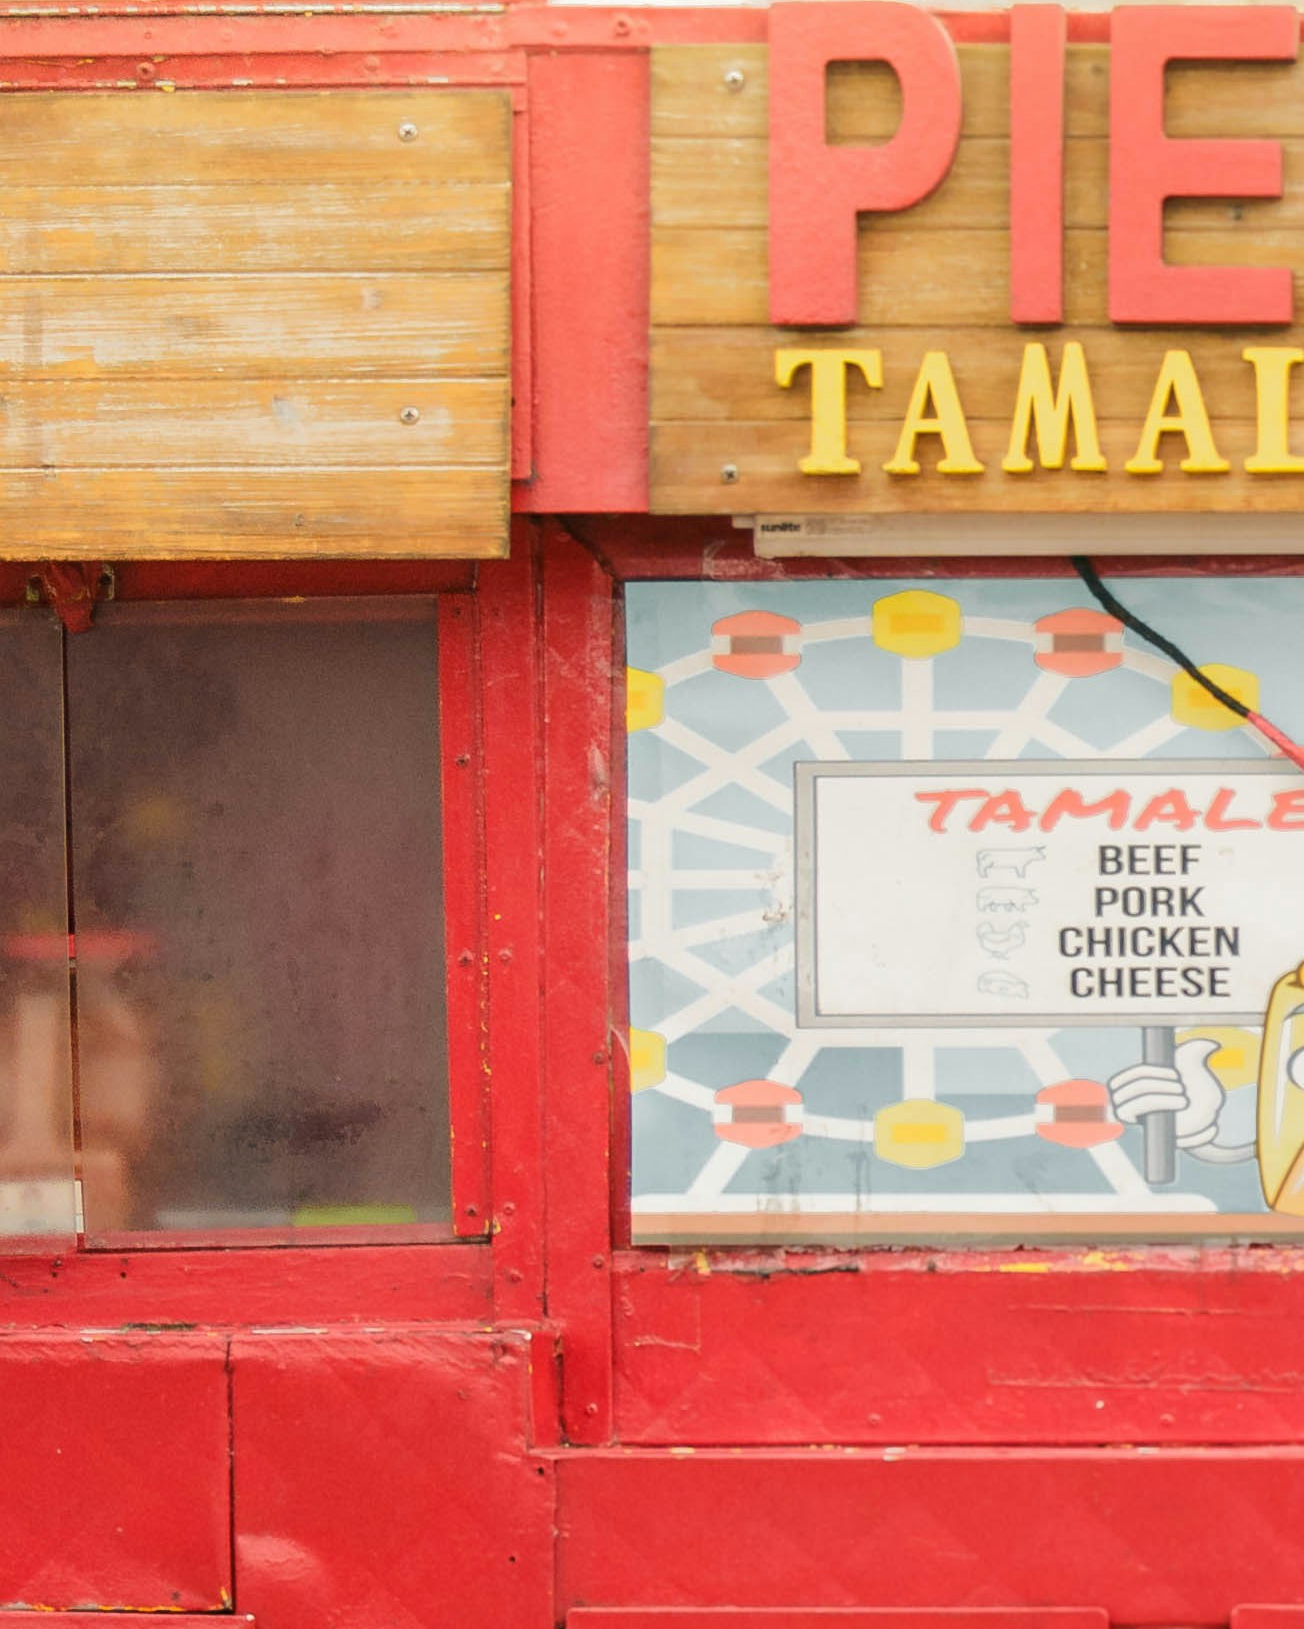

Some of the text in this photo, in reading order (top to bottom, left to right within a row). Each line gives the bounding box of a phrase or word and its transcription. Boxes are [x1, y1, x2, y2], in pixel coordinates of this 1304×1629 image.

[1097, 845, 1202, 875] BEEF
[1094, 886, 1206, 918] PORK
[1058, 926, 1241, 958] CHICKEN
[1069, 966, 1231, 998] CHEESE
